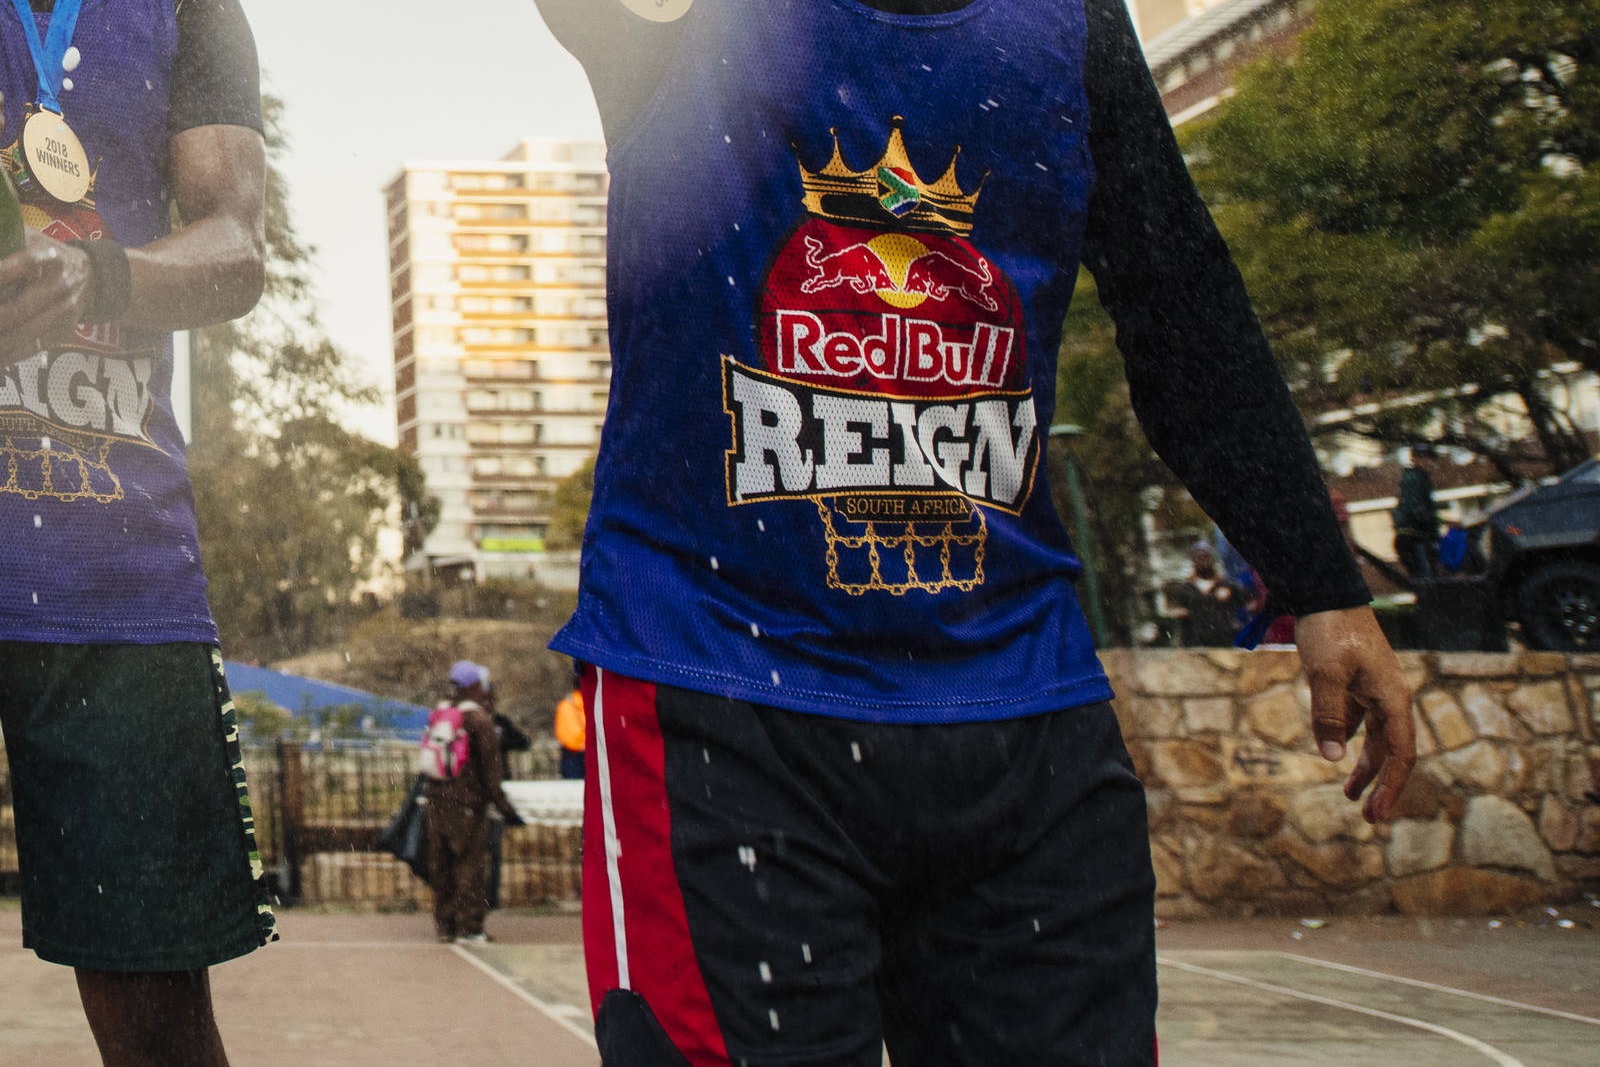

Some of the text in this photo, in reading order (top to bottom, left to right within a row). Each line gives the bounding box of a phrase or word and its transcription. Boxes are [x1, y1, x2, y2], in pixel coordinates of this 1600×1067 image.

[45, 137, 68, 158] 2018
[36, 148, 80, 177] WINNERS
[733, 371, 1038, 505] REIGN
[846, 497, 969, 515] SOUTH AFRICA
